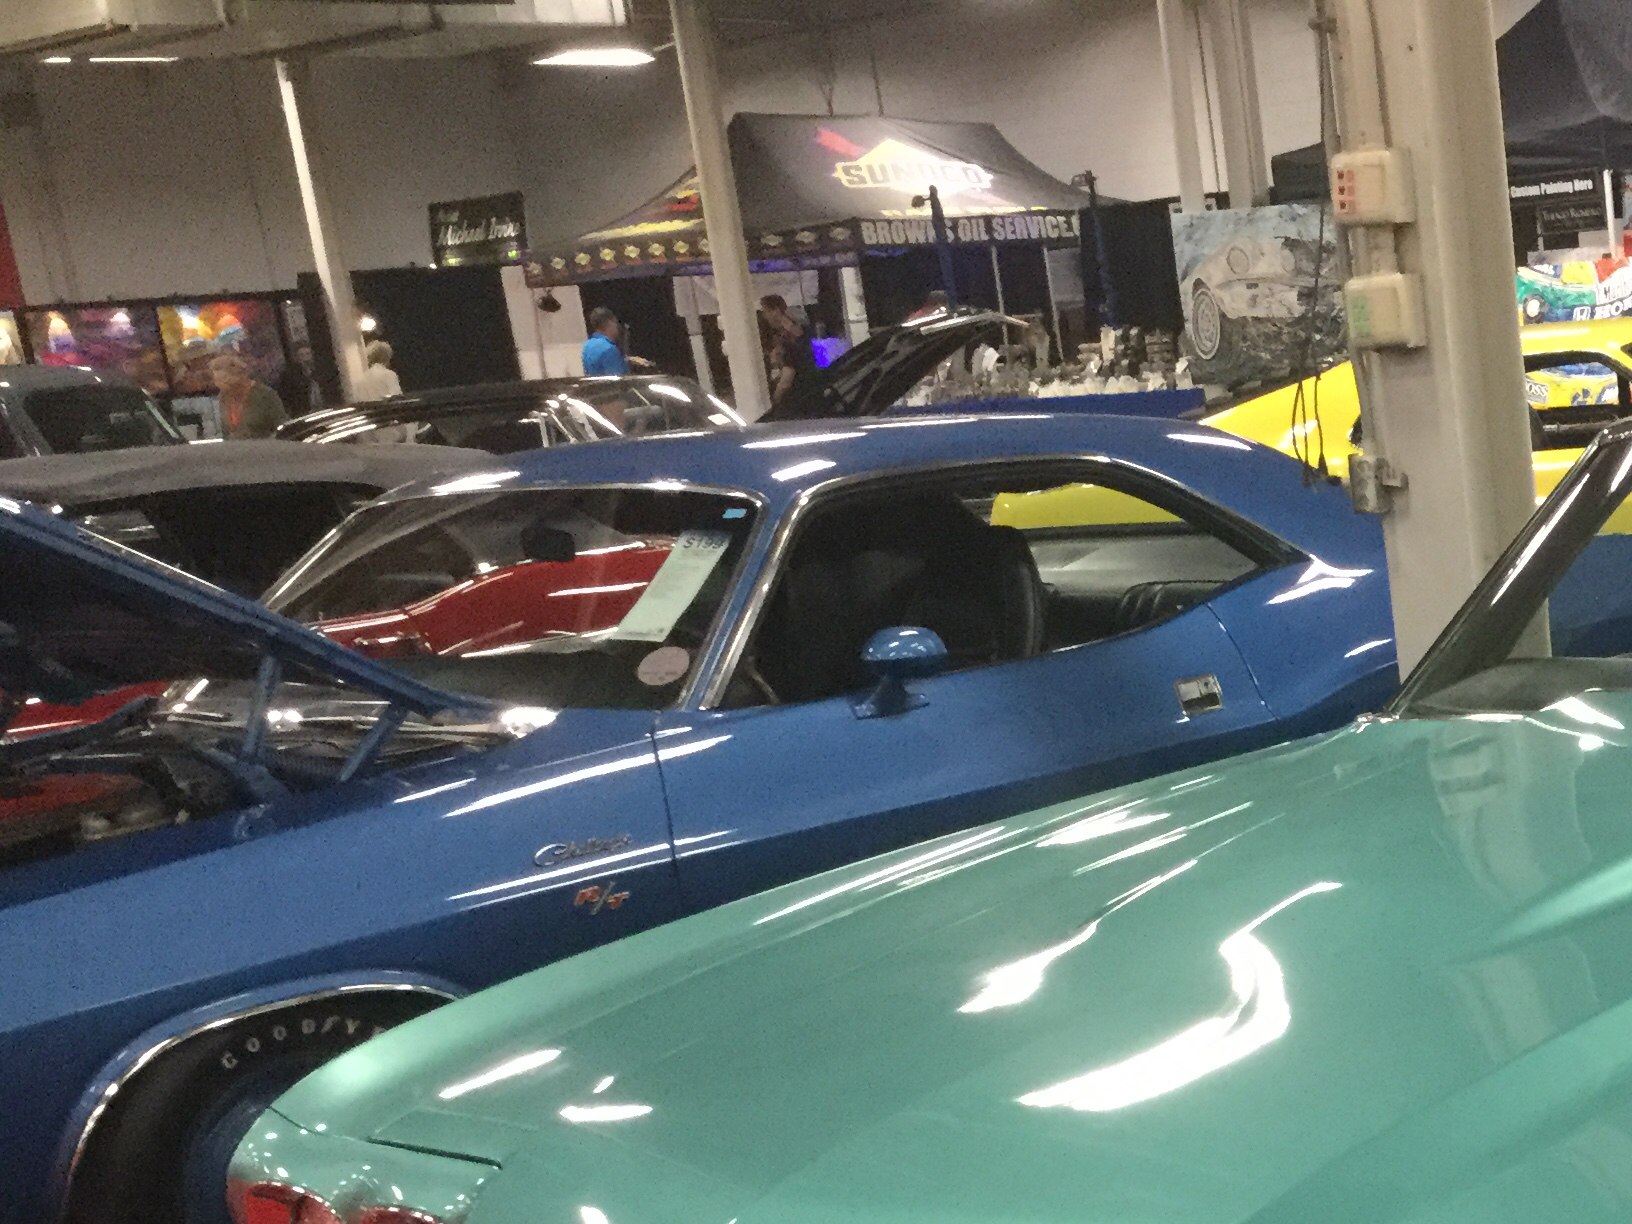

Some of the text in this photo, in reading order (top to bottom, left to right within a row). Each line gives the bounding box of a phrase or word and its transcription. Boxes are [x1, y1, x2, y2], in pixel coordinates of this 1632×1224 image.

[842, 162, 984, 186] SUNOCO
[1510, 179, 1594, 198] Custom Painting Here
[957, 217, 990, 242] OIL
[574, 881, 630, 915] R/T
